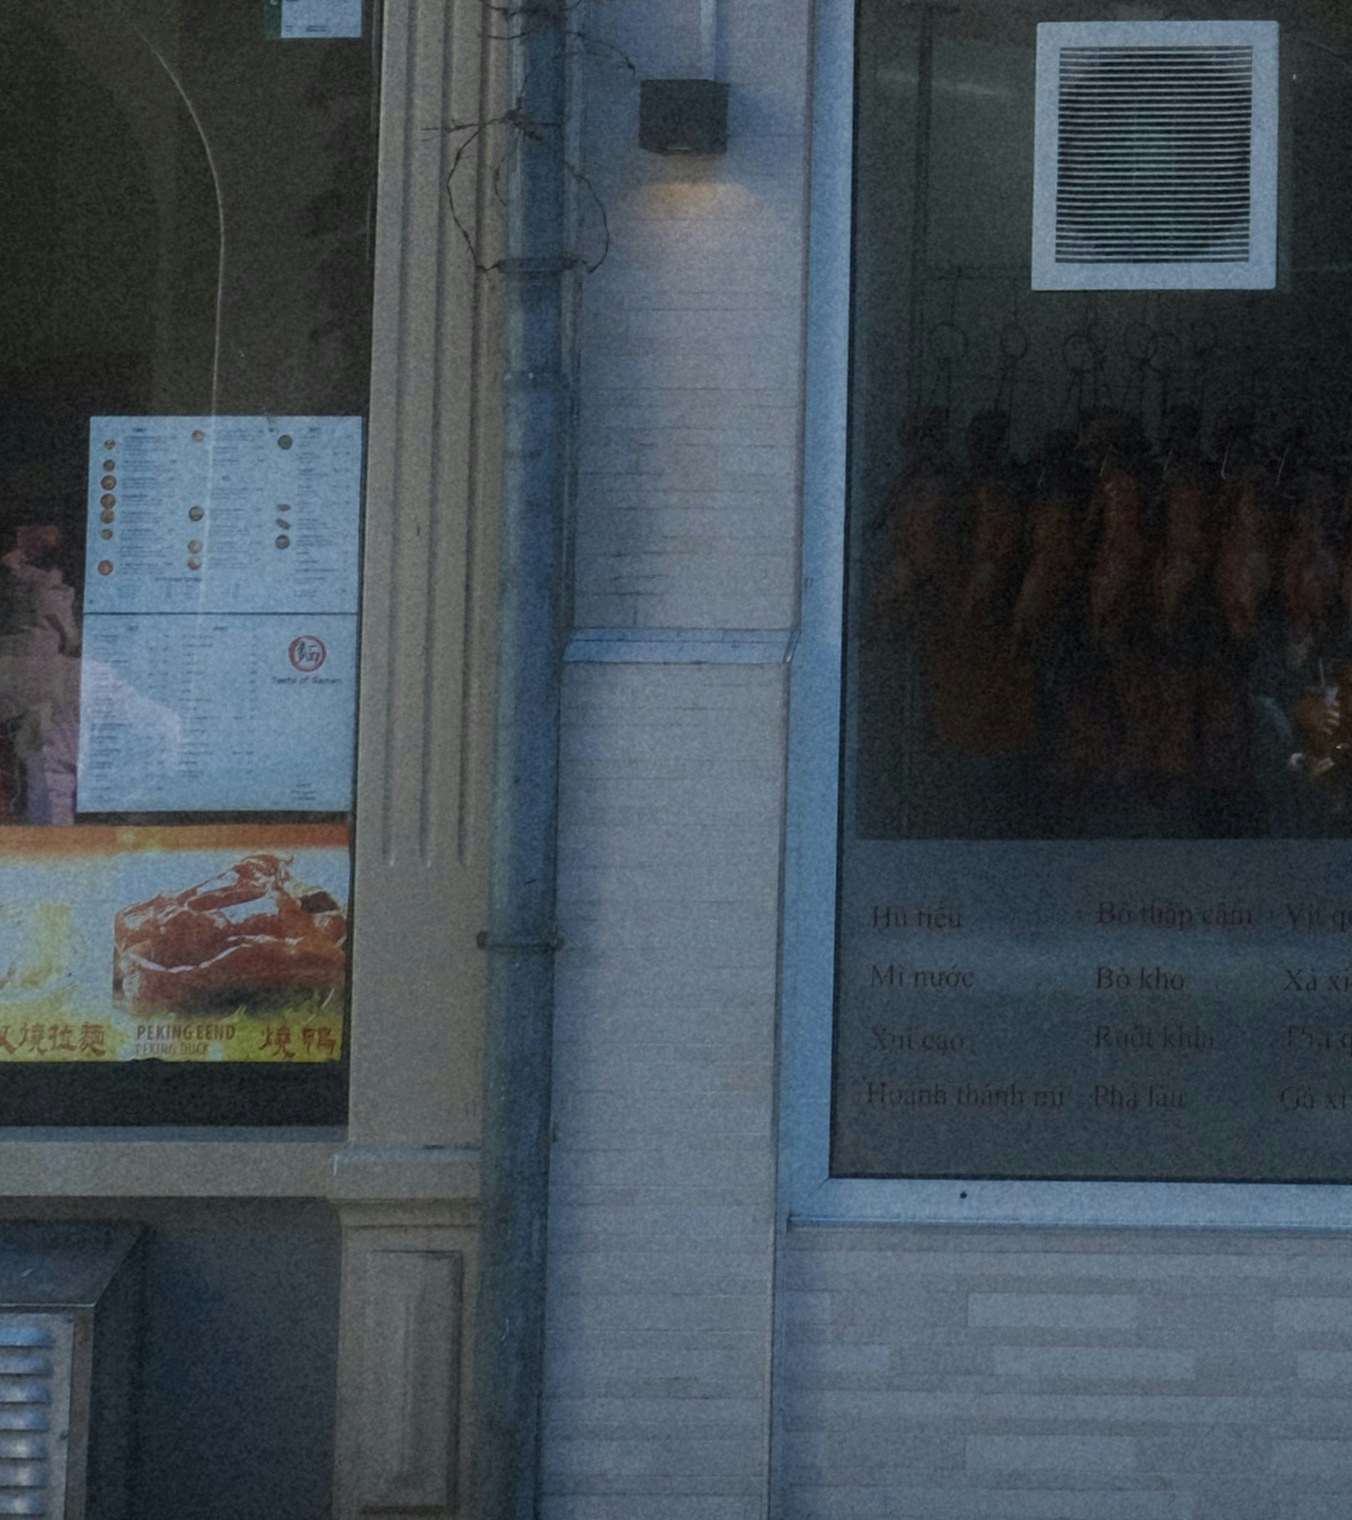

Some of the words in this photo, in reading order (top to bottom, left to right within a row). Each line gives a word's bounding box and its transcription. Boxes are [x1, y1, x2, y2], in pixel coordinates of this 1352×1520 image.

[1140, 966, 1185, 991] kho
[136, 1024, 197, 1041] PEKING
[198, 1025, 235, 1041] EEND
